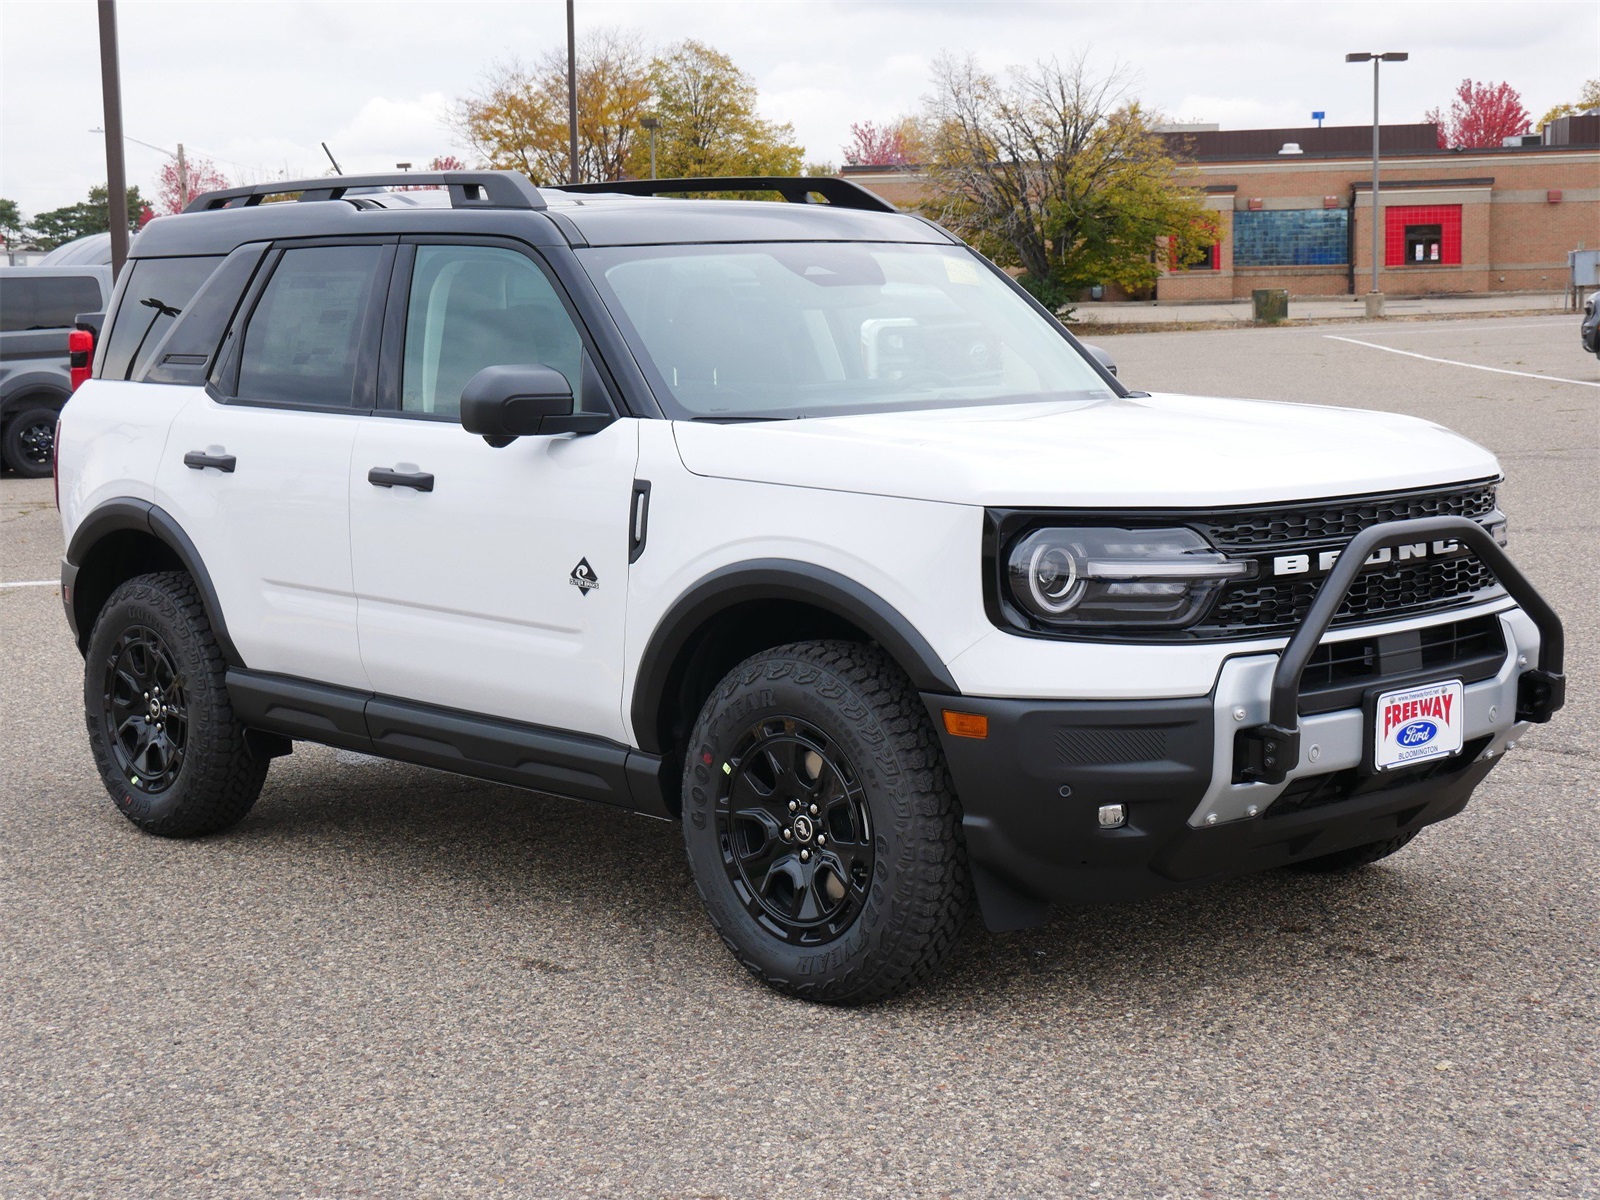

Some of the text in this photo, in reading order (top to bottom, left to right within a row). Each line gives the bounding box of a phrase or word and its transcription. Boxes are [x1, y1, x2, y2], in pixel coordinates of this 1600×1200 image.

[1273, 539, 1469, 576] BRONC
[1384, 693, 1453, 742] FREEWAY
[1403, 724, 1431, 744] Ford
[1398, 745, 1439, 760] BLOOMINGTON
